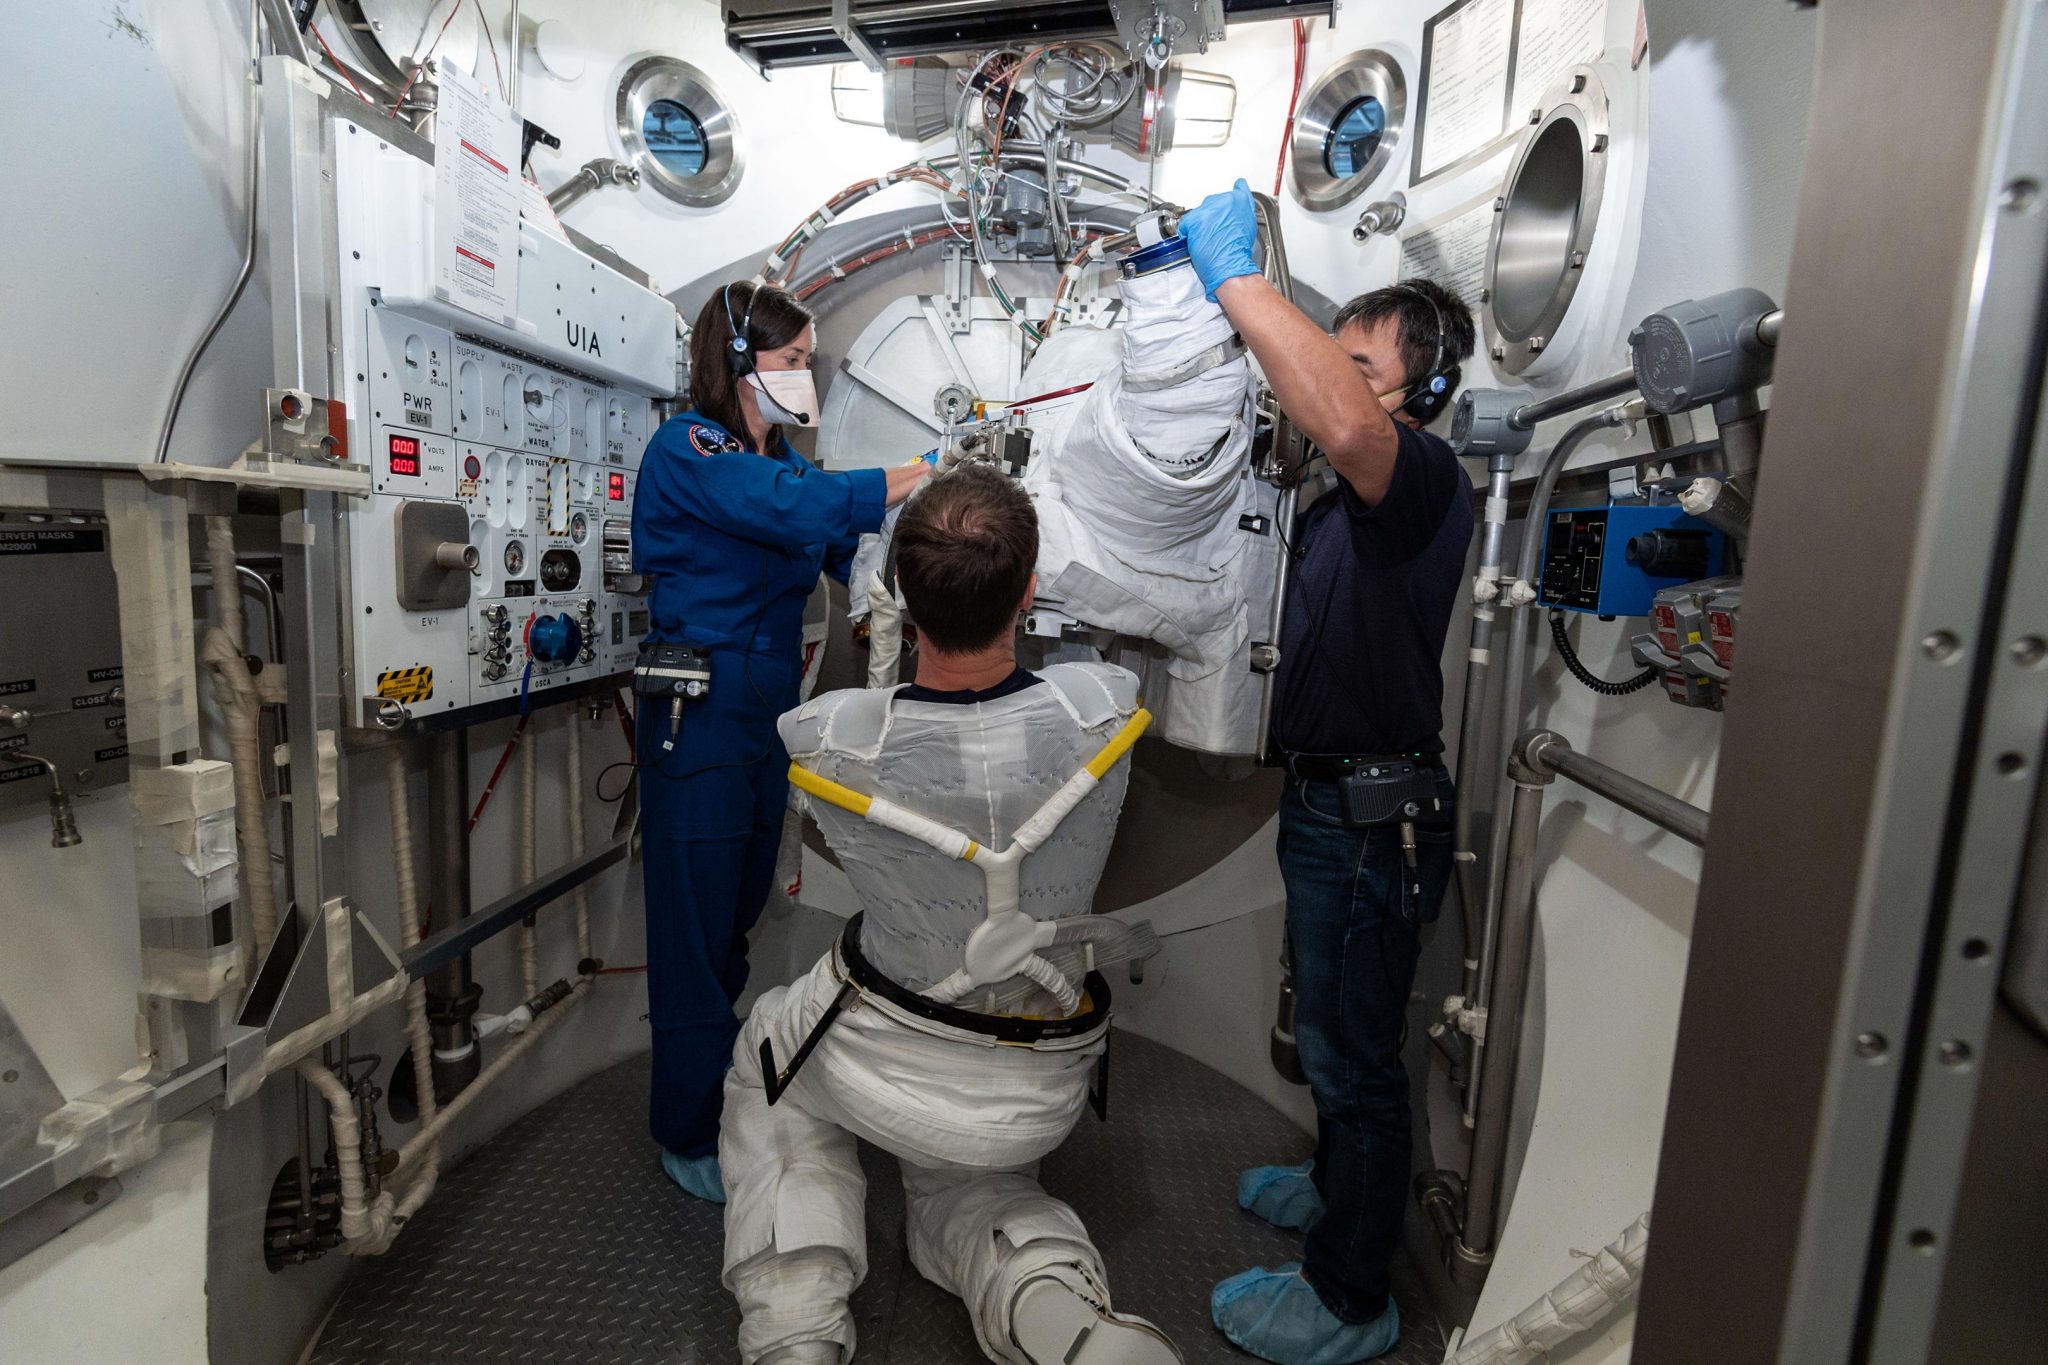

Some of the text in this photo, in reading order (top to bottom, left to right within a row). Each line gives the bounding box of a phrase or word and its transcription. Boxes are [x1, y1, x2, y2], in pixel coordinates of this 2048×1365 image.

[566, 319, 602, 358] UIA
[456, 346, 486, 361] SUPPLY
[429, 358, 441, 367] EMU
[500, 360, 524, 374] WASTE
[430, 378, 449, 388] ORLAN
[550, 375, 573, 389] SUPPLY
[582, 386, 601, 398] WASTE
[403, 392, 433, 412] PWR
[485, 406, 501, 418] EV-1
[410, 413, 428, 425] EV-1
[528, 437, 550, 448] WATER
[608, 440, 624, 453] PWR
[427, 447, 446, 455] VOLTS
[525, 458, 549, 467] OXYGEN
[428, 465, 444, 473] AMPS
[38, 531, 75, 540] MASKS
[421, 616, 439, 627] EV-1
[535, 679, 551, 688] OSCA
[75, 695, 107, 706] CLOSE
